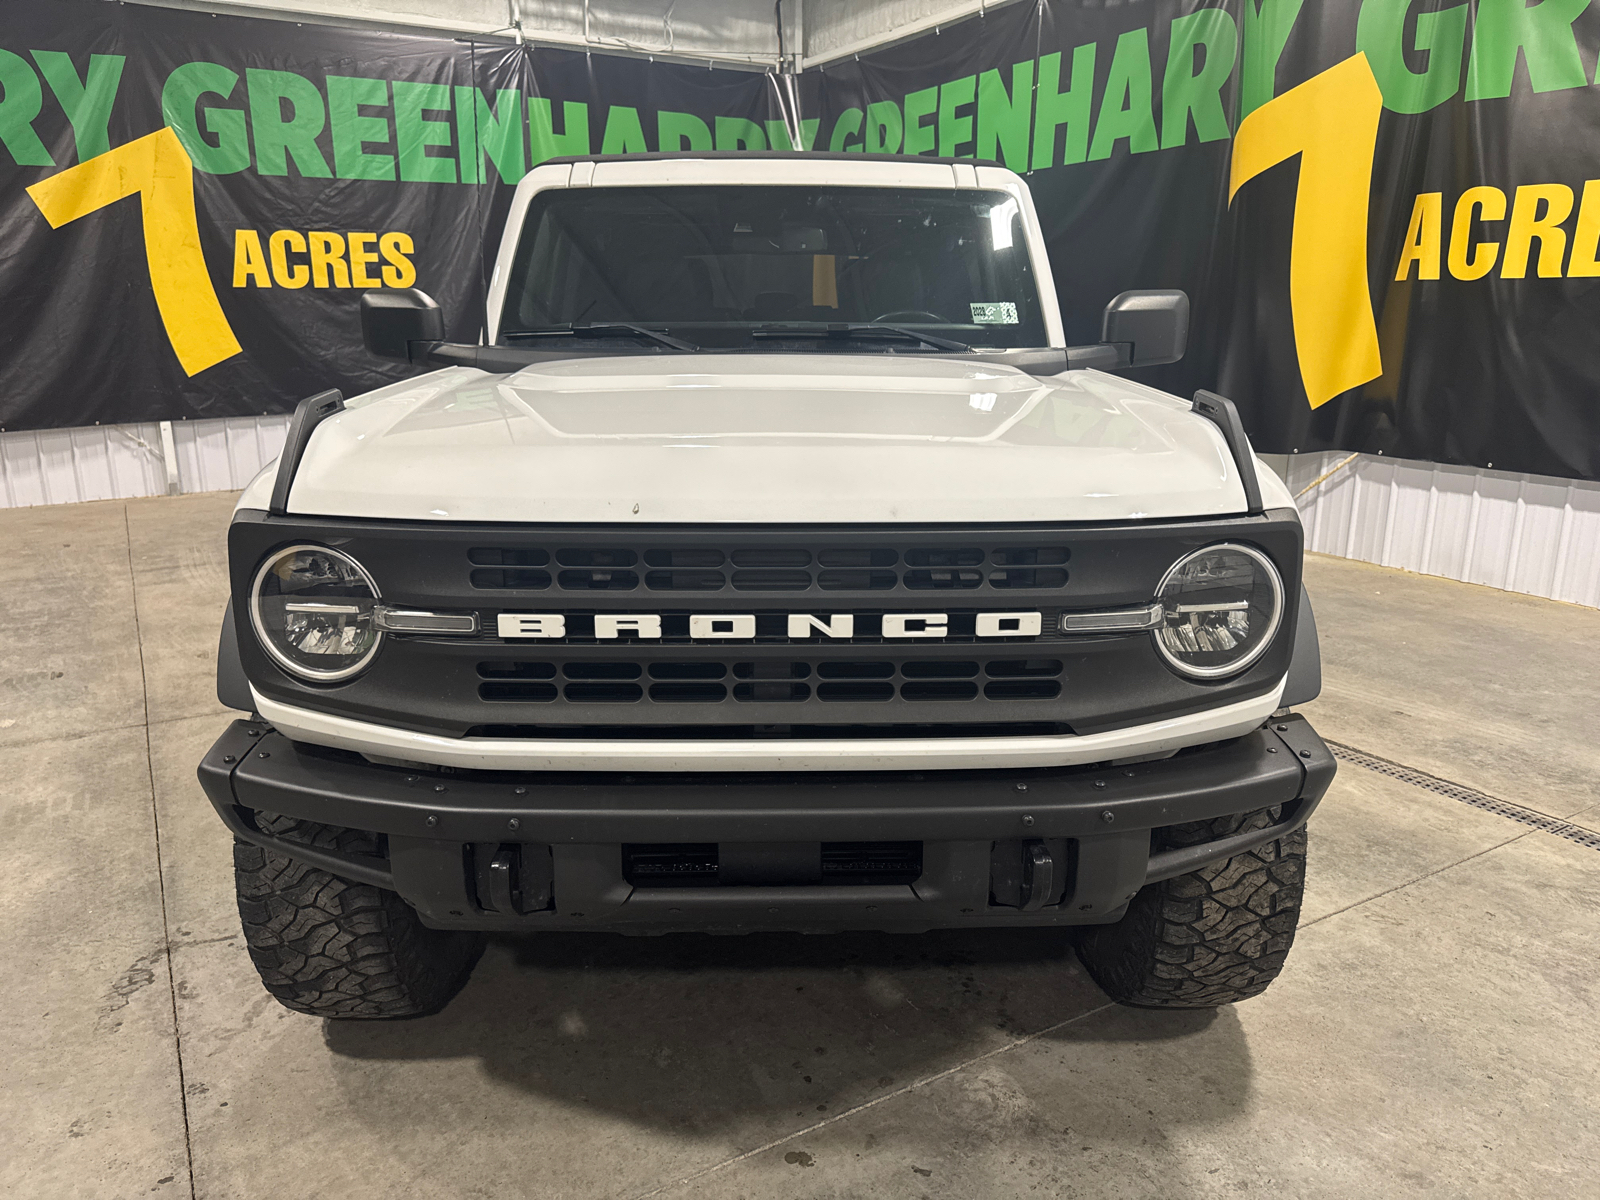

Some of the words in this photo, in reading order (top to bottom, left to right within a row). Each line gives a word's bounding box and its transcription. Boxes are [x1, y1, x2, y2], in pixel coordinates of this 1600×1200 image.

[1356, 0, 1600, 114] GR
[161, 61, 527, 185] GREEN
[25, 126, 243, 378] 7
[232, 229, 416, 290] ACRES
[1228, 51, 1383, 410] 7
[497, 611, 1042, 638] BRONCO
